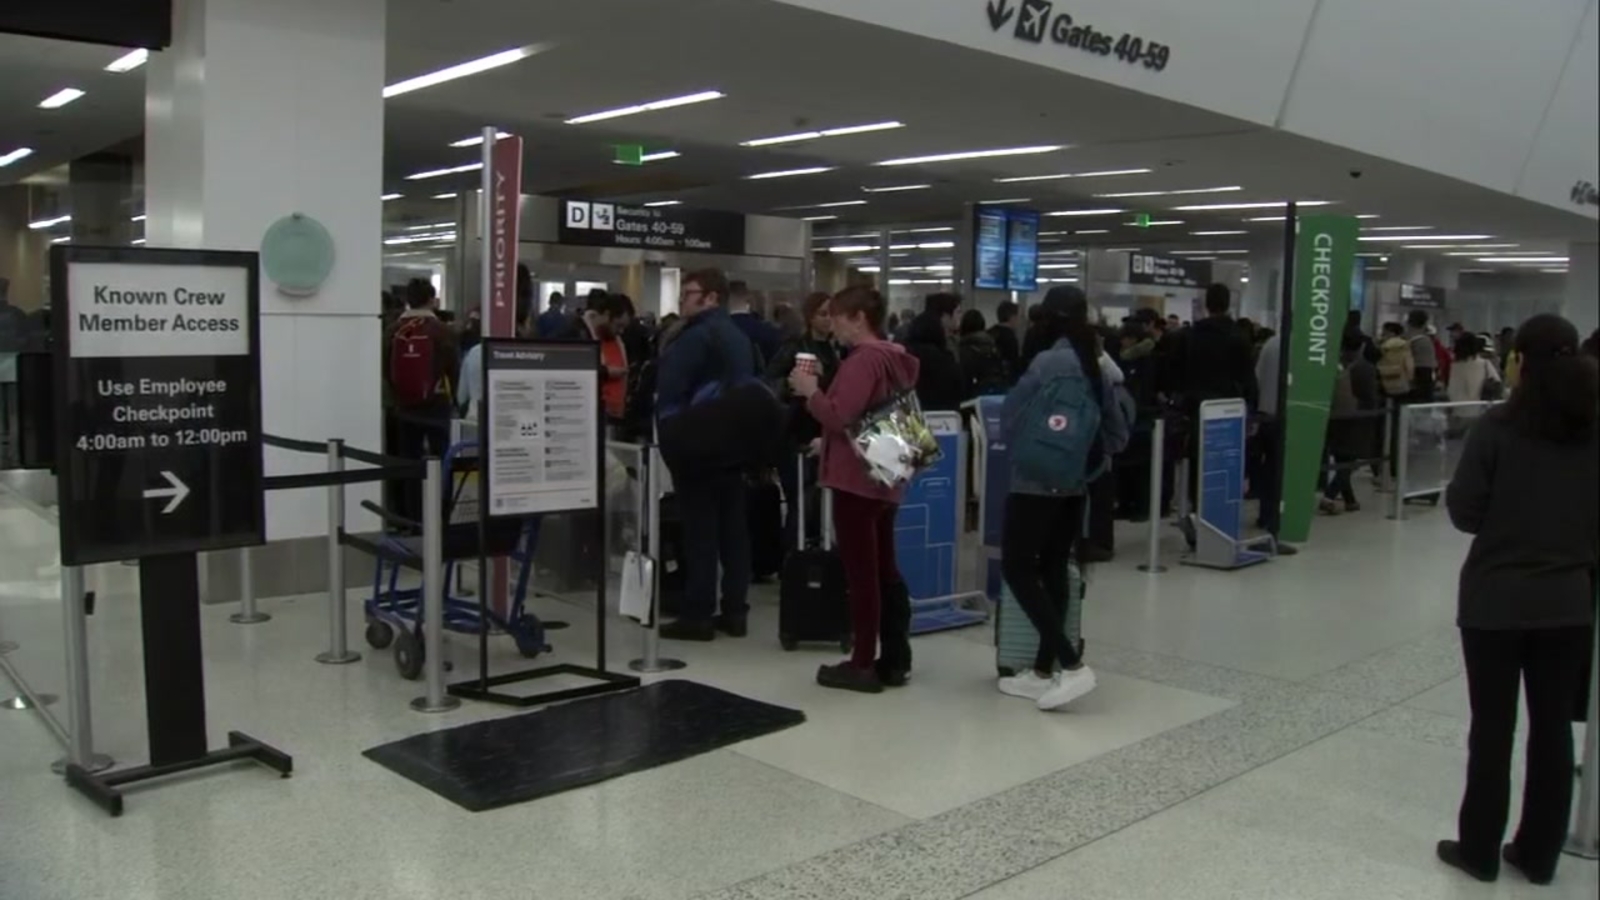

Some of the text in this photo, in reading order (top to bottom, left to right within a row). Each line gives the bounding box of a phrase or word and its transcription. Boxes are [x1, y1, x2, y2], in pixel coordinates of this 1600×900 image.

[1051, 14, 1170, 71] Gates 40-59
[572, 207, 585, 223] D
[616, 219, 685, 235] Gates 40-59
[496, 171, 505, 307] PRIORITY
[94, 286, 226, 305] Known Crew
[1308, 233, 1333, 366] CHECKPOINT
[79, 312, 240, 332] Member Access
[515, 351, 545, 362] Advisory
[98, 378, 227, 397] Use Employee
[113, 403, 215, 423] Checkpoint
[76, 428, 247, 450] 4:00am to 12:00pm
